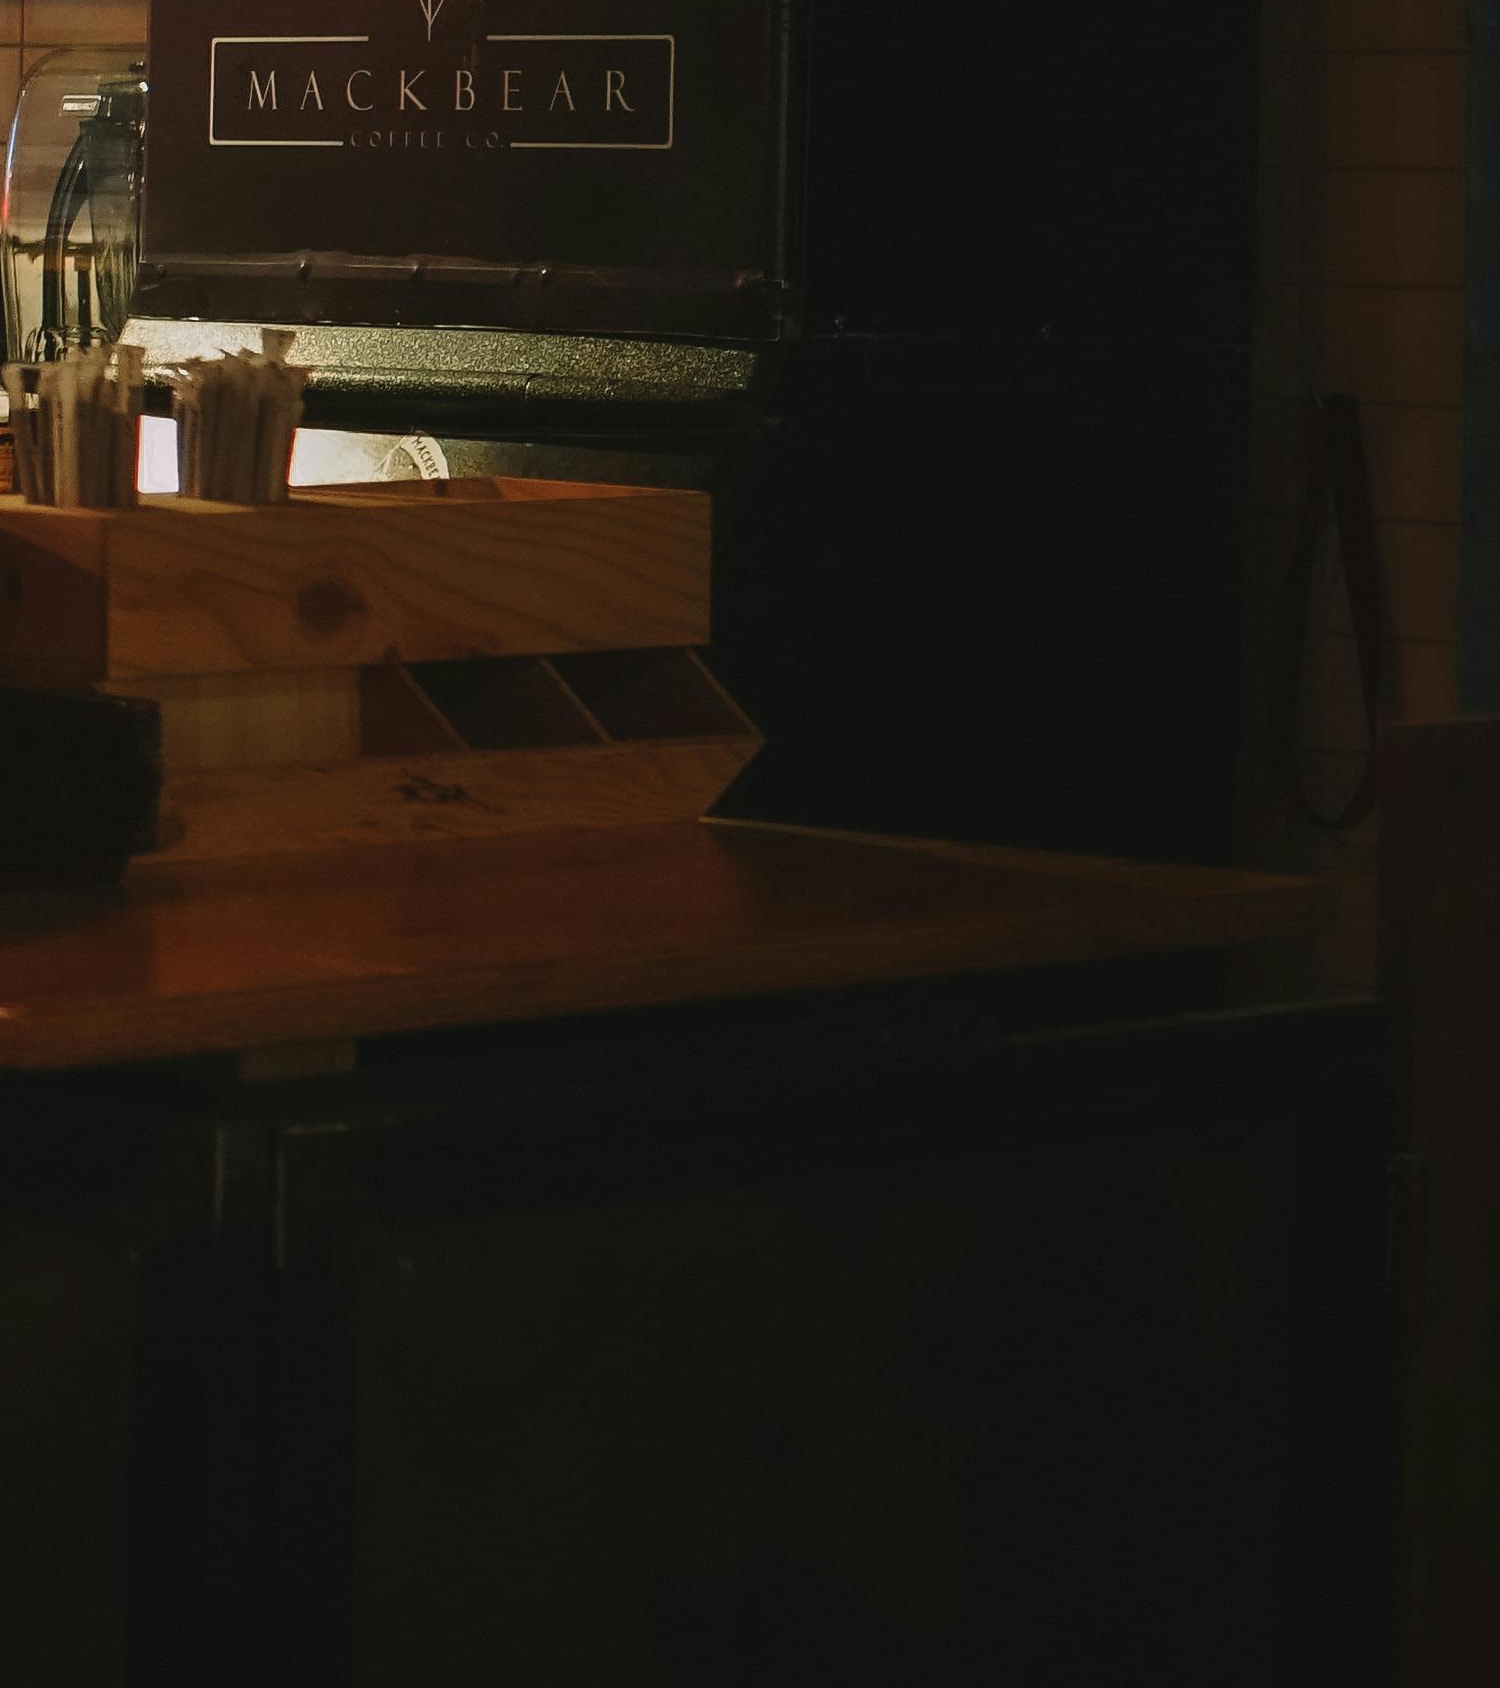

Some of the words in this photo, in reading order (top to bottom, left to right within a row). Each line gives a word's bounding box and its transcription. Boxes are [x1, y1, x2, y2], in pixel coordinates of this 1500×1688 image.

[247, 69, 636, 112] MACKBEAR
[350, 130, 445, 149] COFFEE
[412, 436, 439, 477] MACKBE
